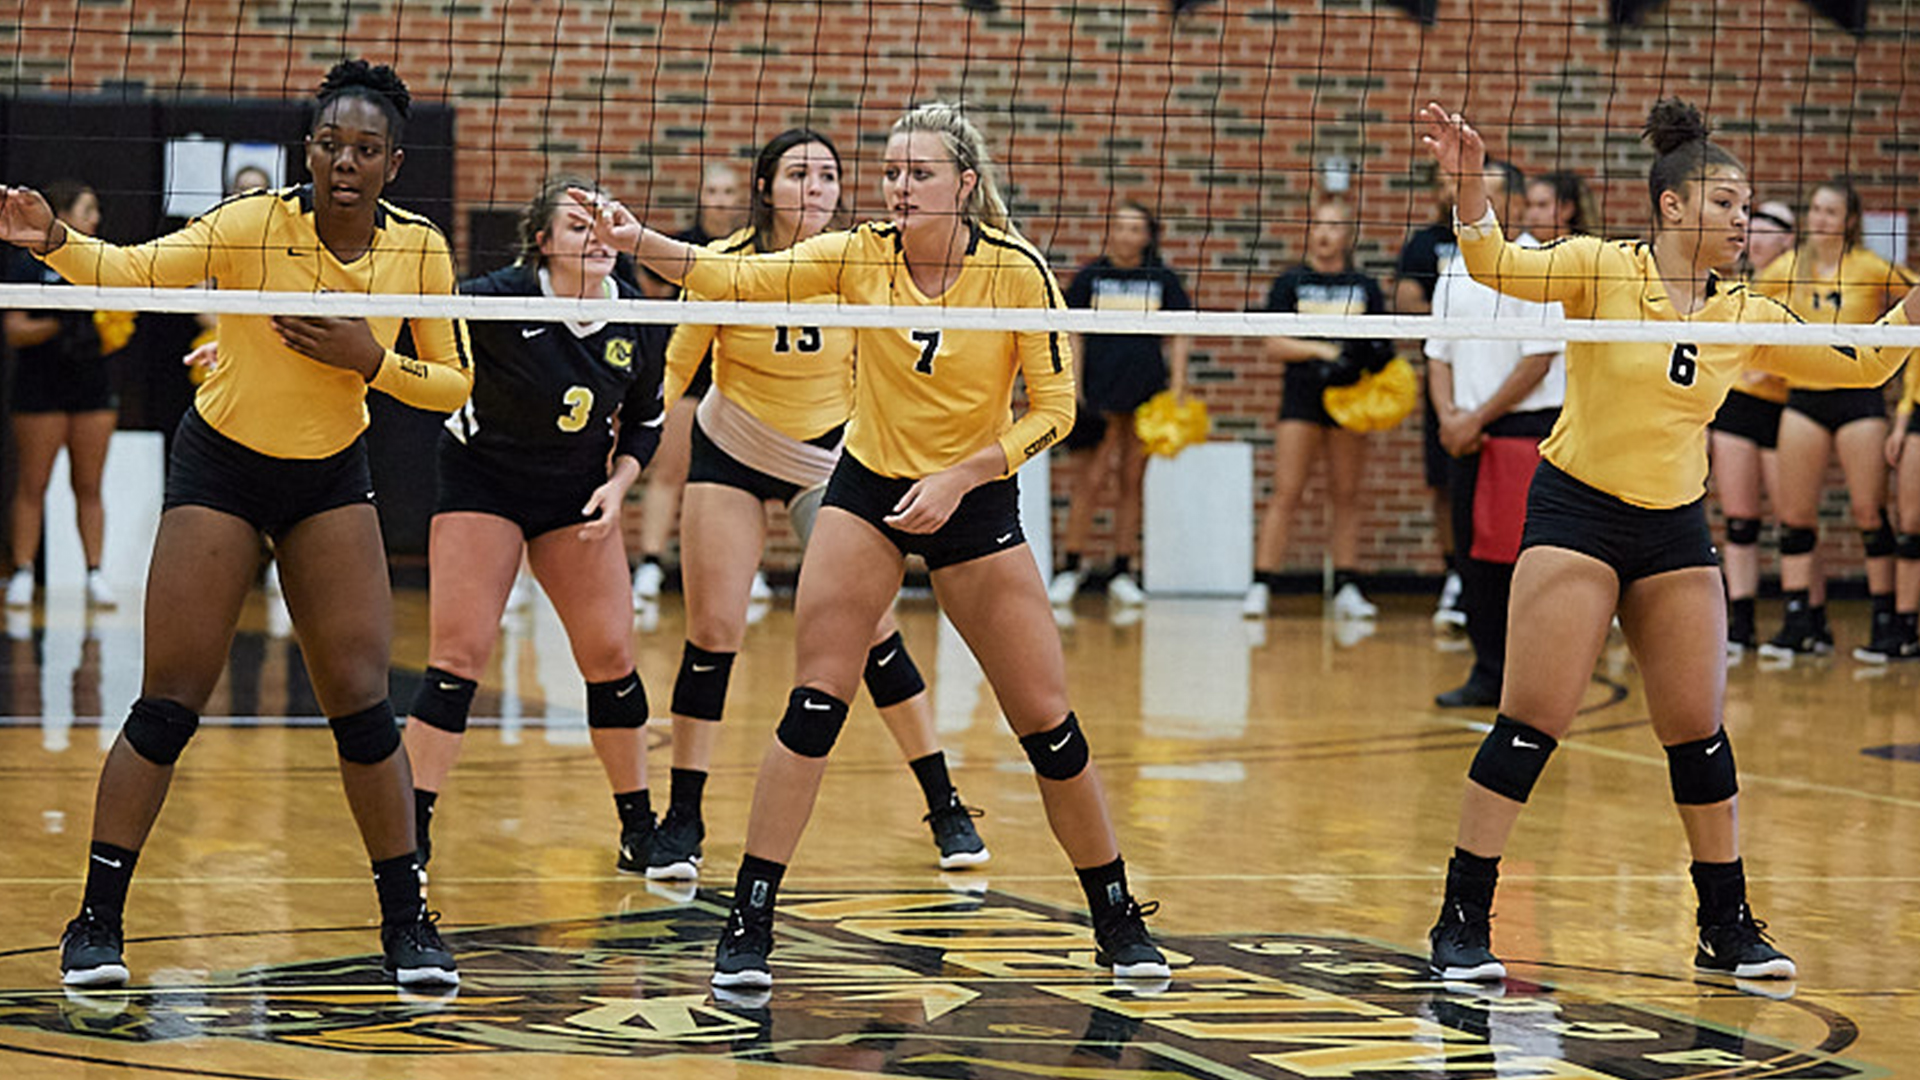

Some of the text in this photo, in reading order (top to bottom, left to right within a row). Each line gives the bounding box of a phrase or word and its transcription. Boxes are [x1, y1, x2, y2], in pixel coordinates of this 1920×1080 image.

[774, 325, 823, 354] 13
[910, 328, 942, 376] 7
[1668, 341, 1699, 388] 6
[557, 385, 595, 433] 3
